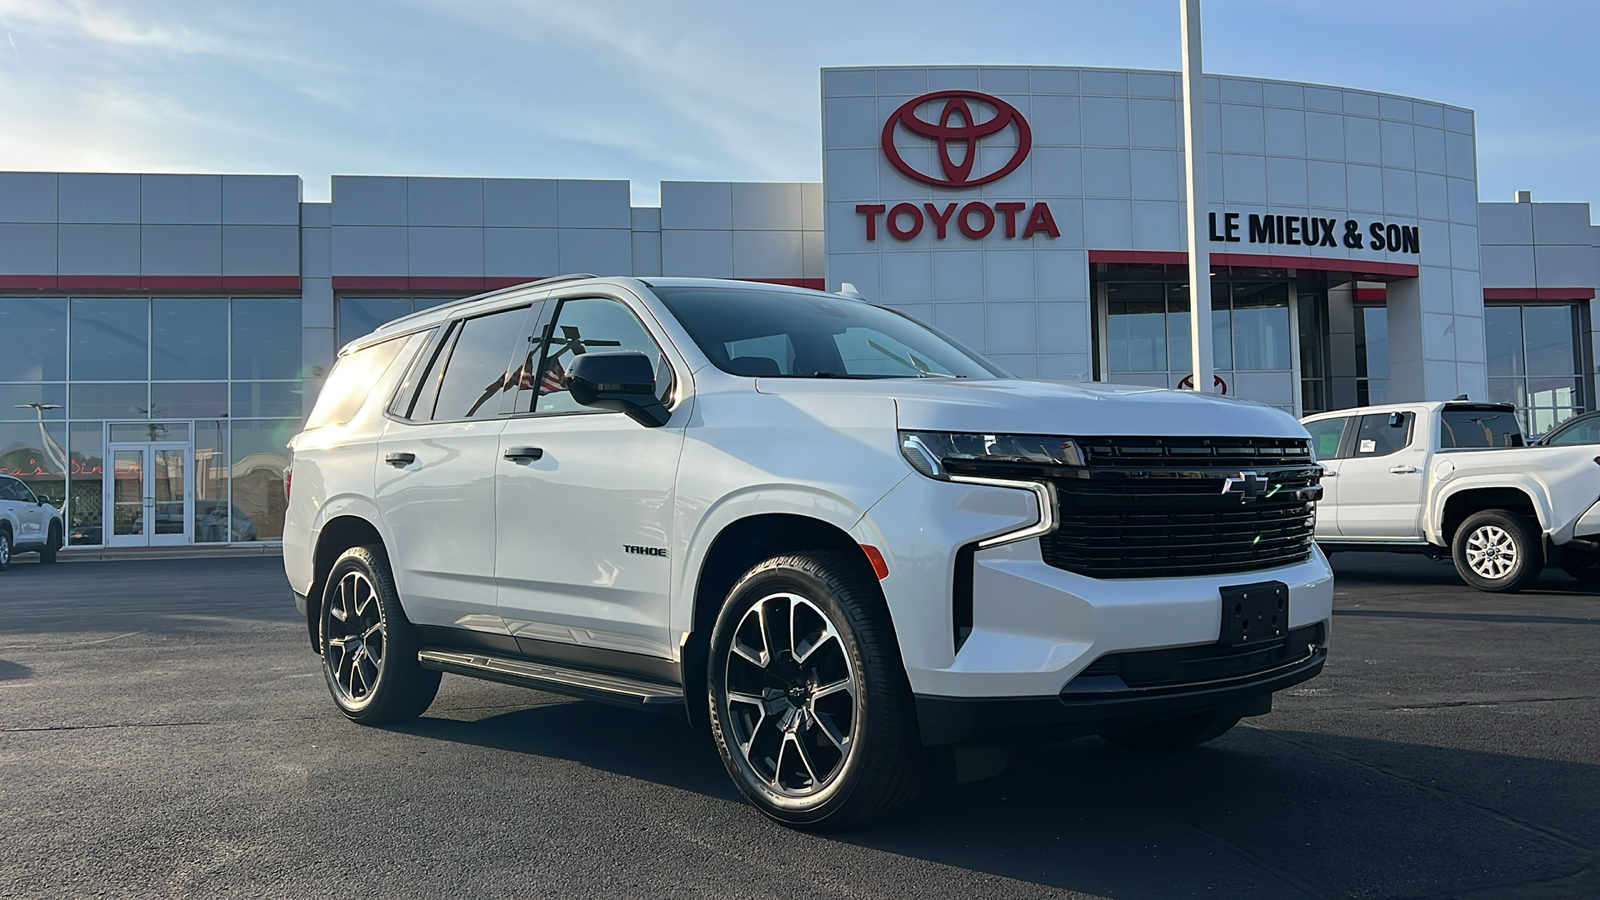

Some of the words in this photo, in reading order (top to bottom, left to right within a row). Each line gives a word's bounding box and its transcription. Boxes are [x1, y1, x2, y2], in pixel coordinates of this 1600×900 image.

[855, 201, 1061, 241] TOYOTA
[1209, 212, 1240, 242] LE
[1249, 214, 1337, 248] MIEUX
[1343, 220, 1363, 249] &
[1370, 222, 1419, 254] SON
[623, 544, 670, 558] TAHOE
